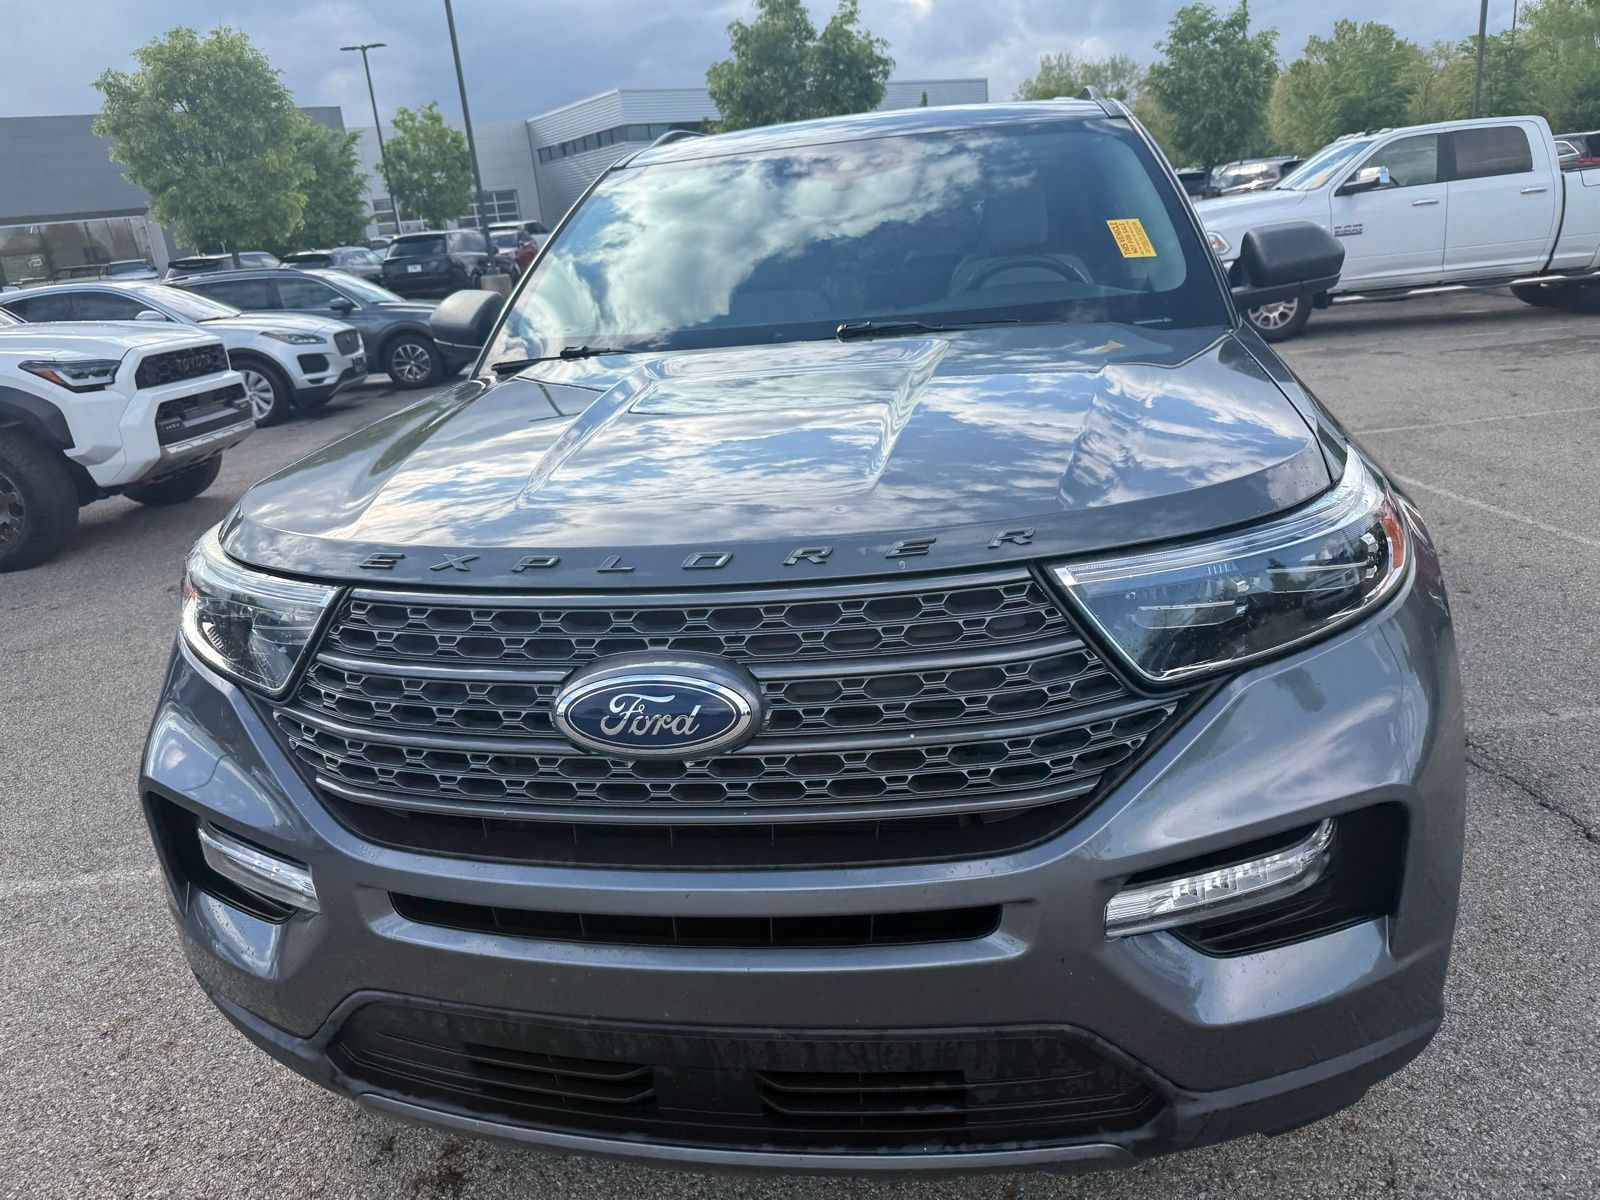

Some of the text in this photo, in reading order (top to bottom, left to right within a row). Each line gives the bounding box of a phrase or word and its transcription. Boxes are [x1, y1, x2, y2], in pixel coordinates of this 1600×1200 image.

[175, 353, 211, 371] TOYOTA
[358, 527, 1037, 573] EXPLORER
[600, 693, 702, 736] Ford
